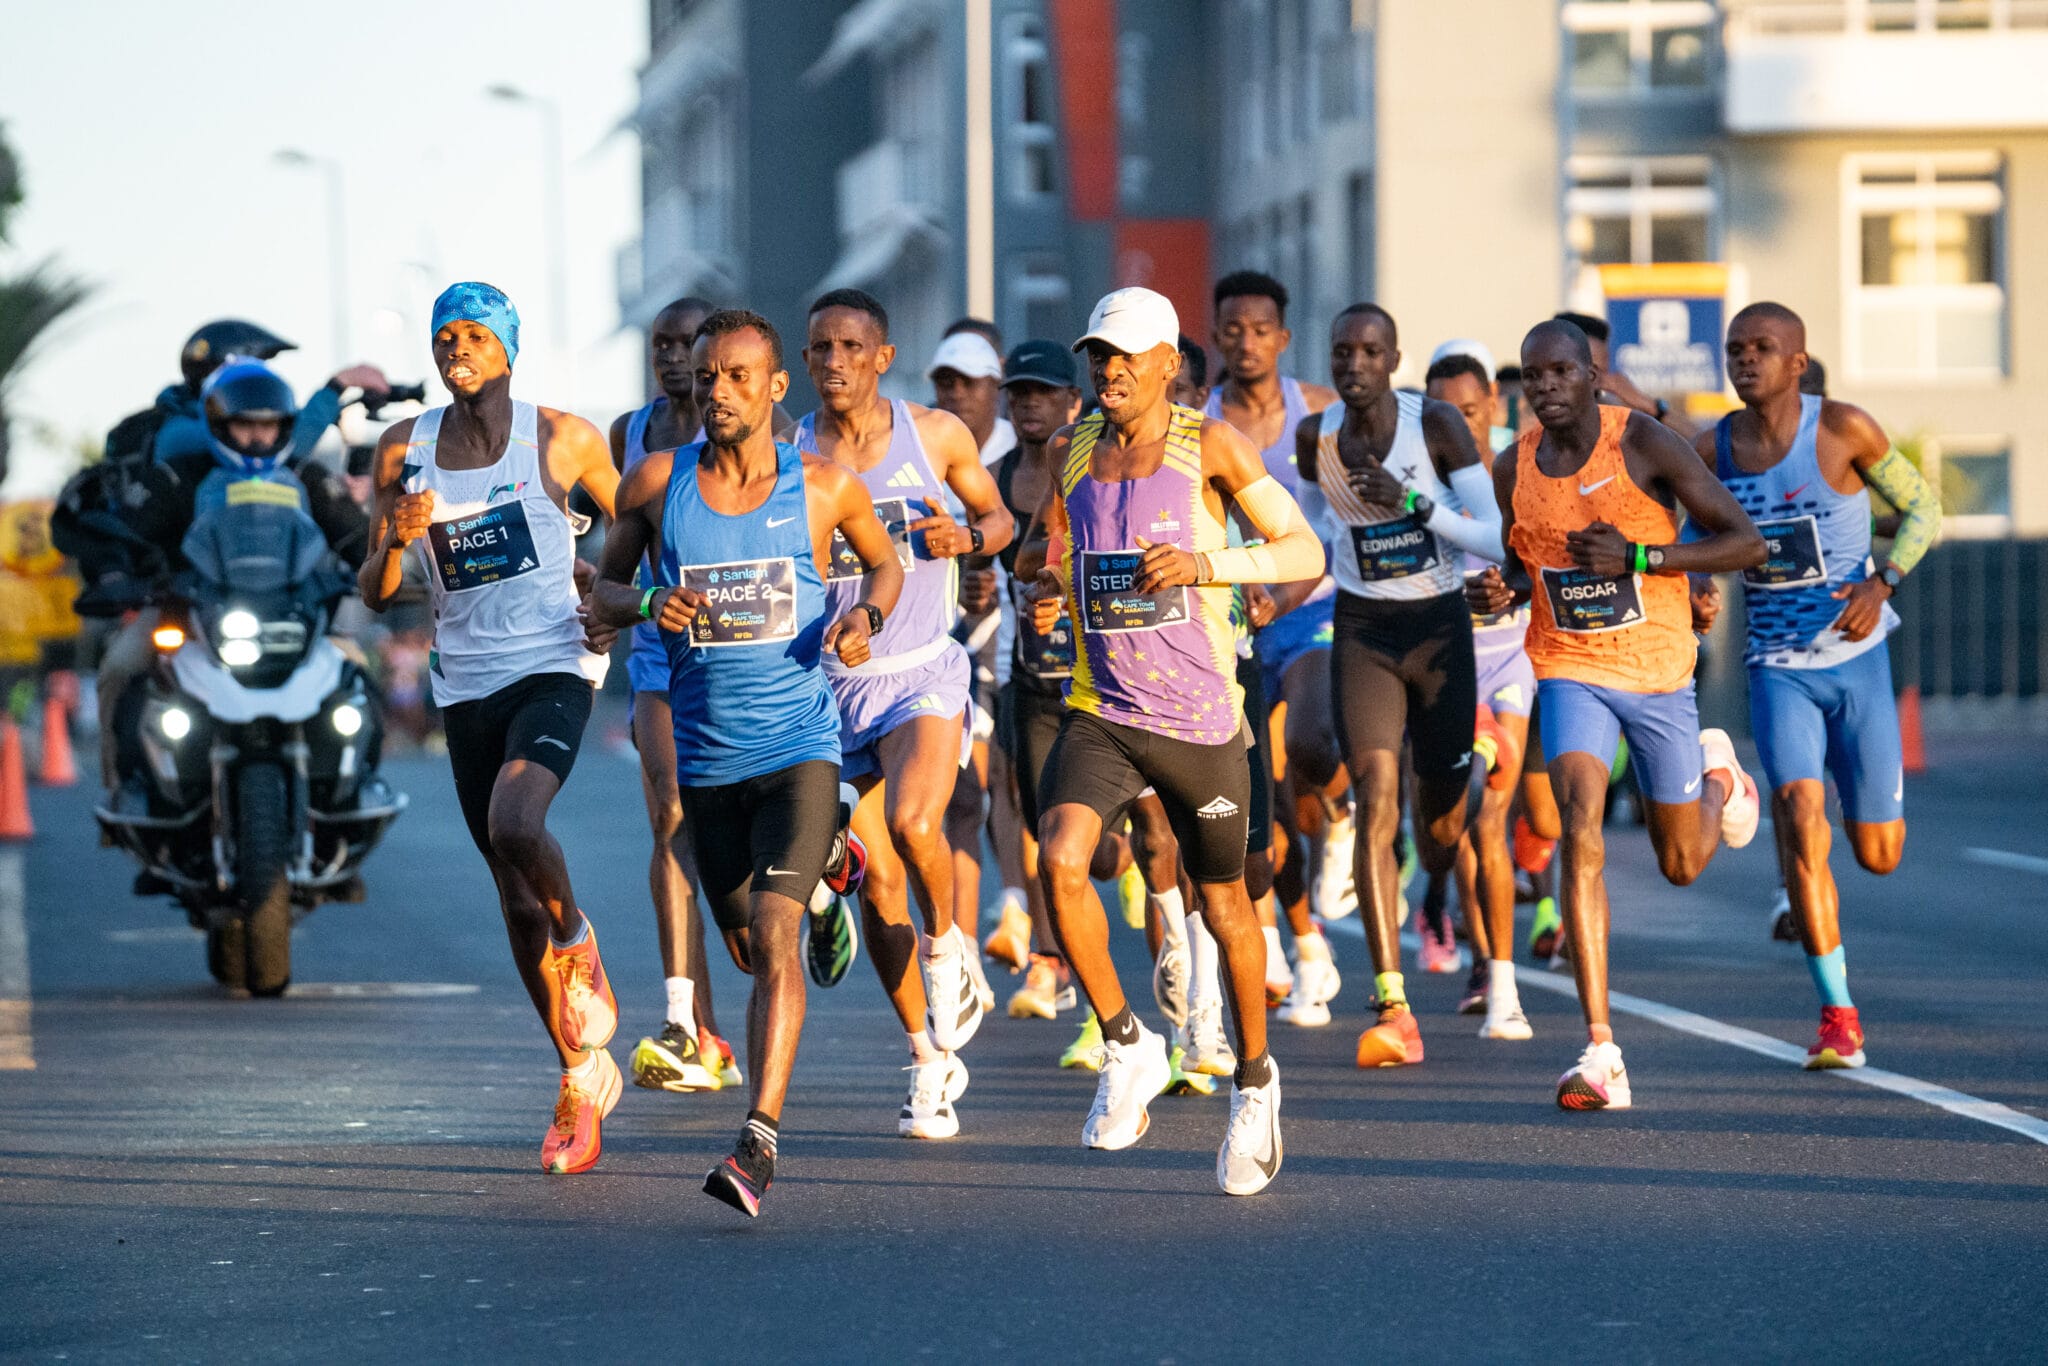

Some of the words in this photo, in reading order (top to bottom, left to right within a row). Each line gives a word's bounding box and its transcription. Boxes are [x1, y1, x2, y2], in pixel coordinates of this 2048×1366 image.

[458, 512, 502, 532] Sanlam
[448, 529, 498, 554] PACE
[498, 526, 509, 541] 1
[1361, 529, 1425, 554] EDWARD
[444, 563, 457, 576] 50
[1112, 557, 1137, 570] Sanl
[722, 568, 769, 581] Sanlam
[706, 585, 758, 603] PACE
[761, 584, 772, 599] 2
[1561, 581, 1618, 600] OSCAR
[1091, 600, 1102, 613] 54
[1124, 606, 1156, 614] MARATHON
[697, 614, 711, 627] 44
